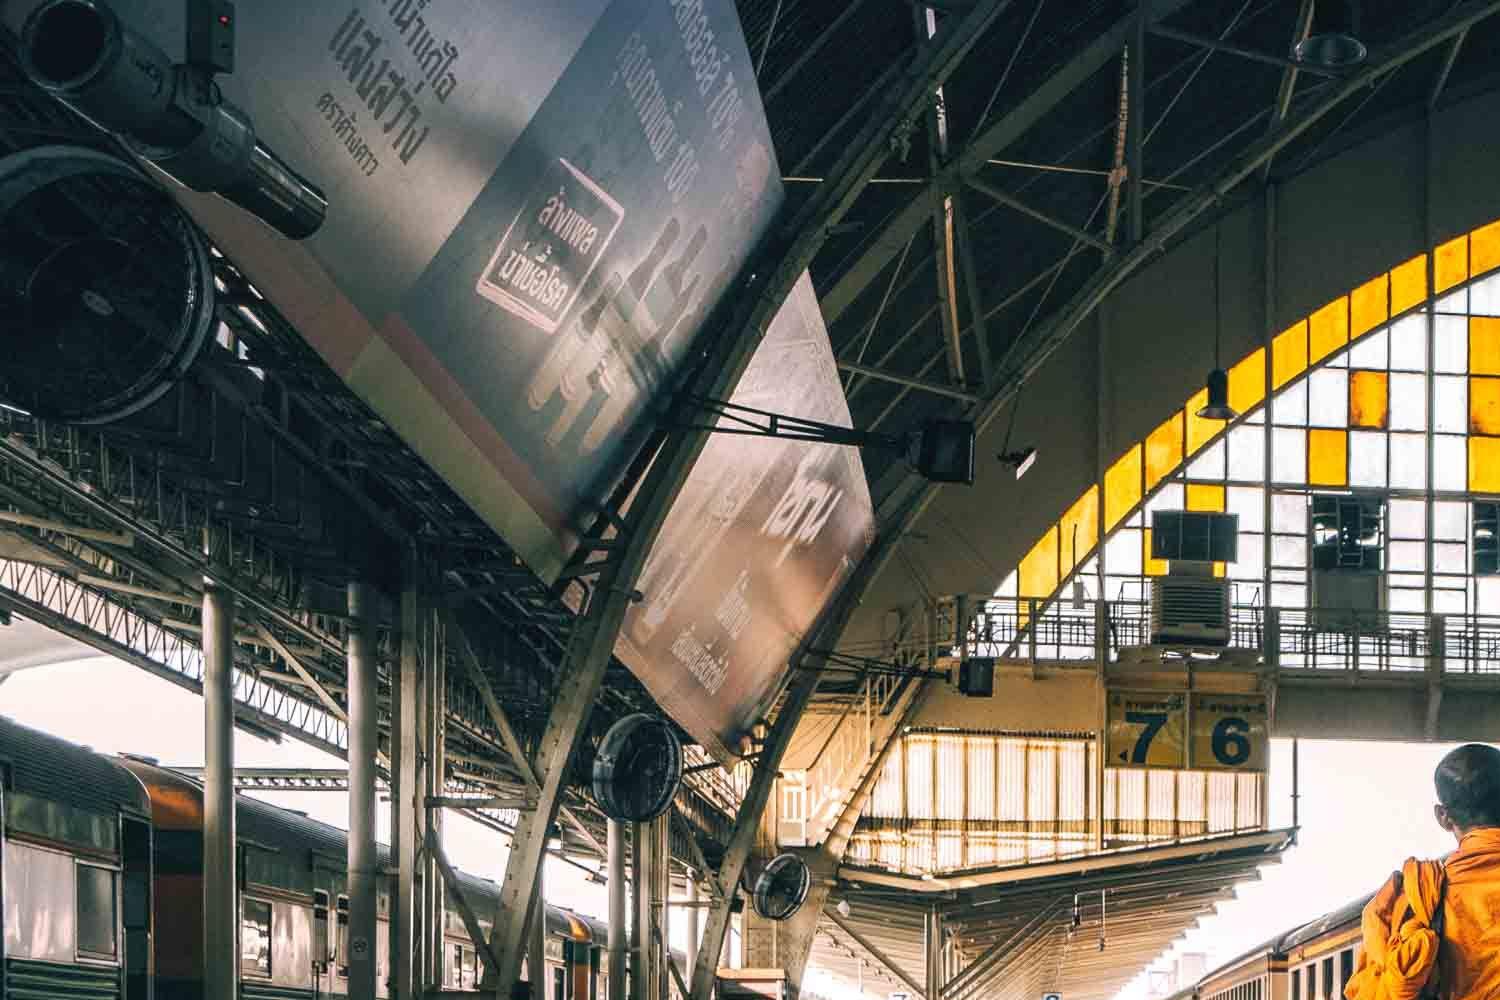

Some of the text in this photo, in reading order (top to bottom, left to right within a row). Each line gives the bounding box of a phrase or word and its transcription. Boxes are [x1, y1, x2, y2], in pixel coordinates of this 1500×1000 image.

[671, 0, 731, 96] ลกอฮอล์
[538, 185, 599, 255] ล้างแผล
[499, 241, 569, 311] ฆ่าเชื้อโรค
[1126, 711, 1168, 764] 7
[1212, 717, 1250, 765] 6
